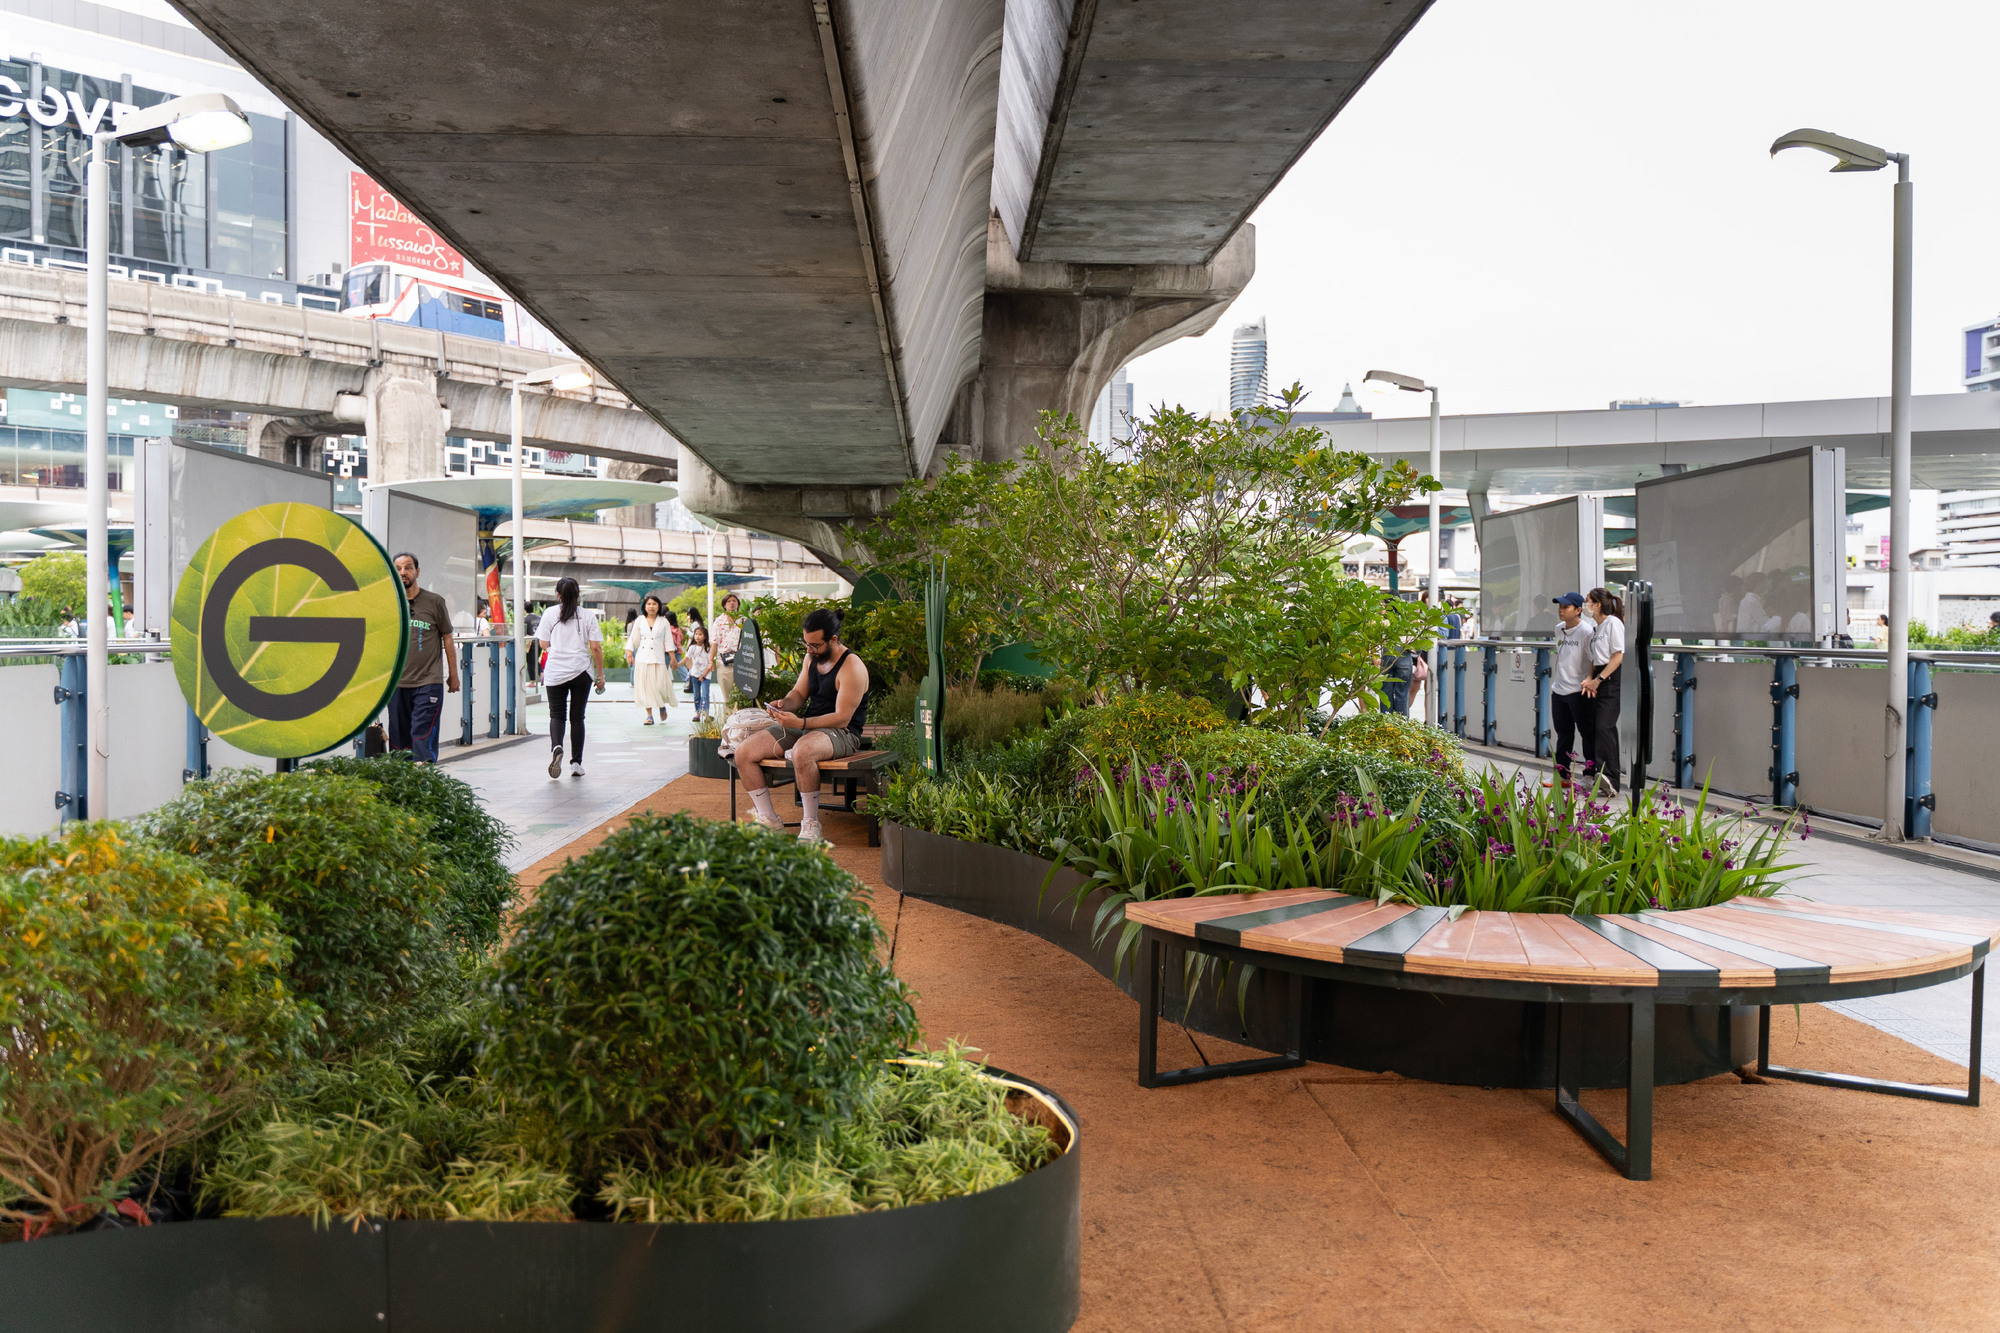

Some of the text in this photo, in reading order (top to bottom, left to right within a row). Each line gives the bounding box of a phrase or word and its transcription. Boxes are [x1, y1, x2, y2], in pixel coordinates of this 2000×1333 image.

[356, 221, 449, 270] Tussauds
[395, 254, 432, 267] BANGKOK
[201, 537, 366, 721] G
[409, 619, 431, 631] YORK
